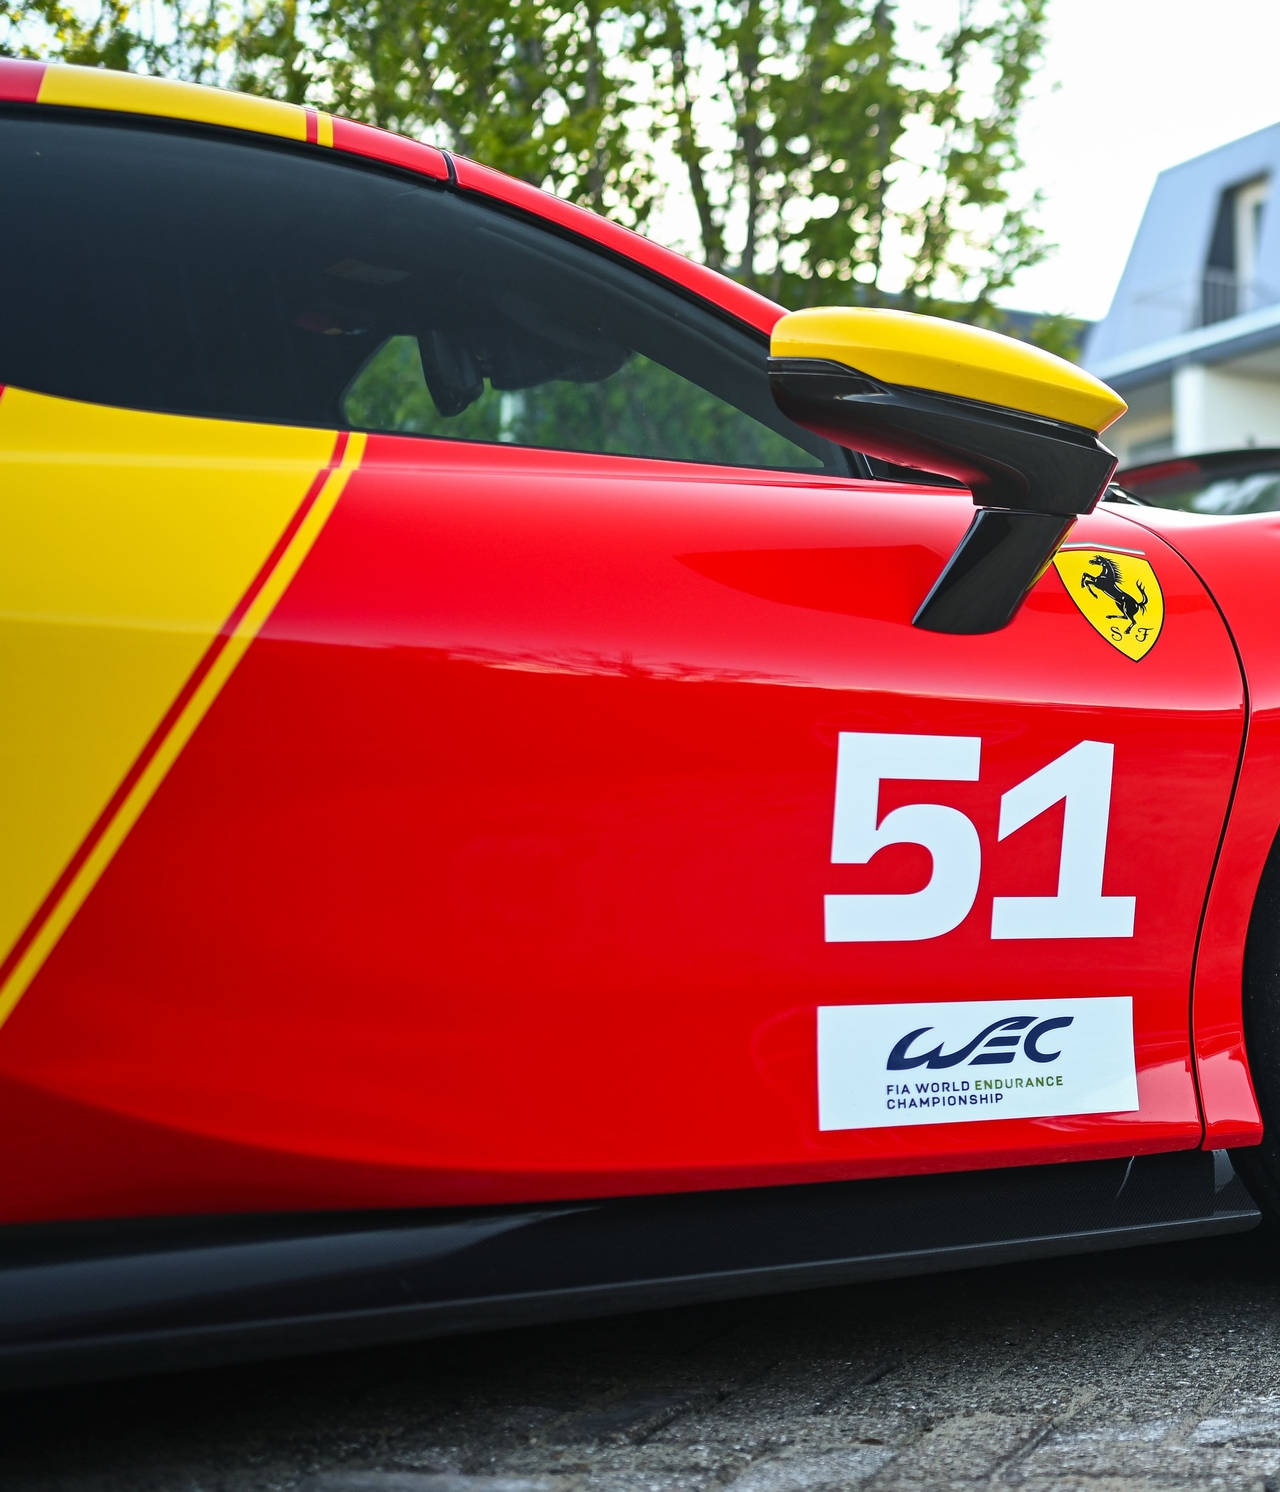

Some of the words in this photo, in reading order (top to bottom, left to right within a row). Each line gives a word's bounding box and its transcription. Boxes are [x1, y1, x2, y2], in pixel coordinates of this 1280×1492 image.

[1110, 626, 1123, 642] S
[1135, 627, 1154, 642] F
[824, 731, 1136, 942] 51
[886, 1016, 1074, 1070] WEC
[886, 1084, 911, 1095] FIA
[915, 1080, 970, 1094] WORLD
[975, 1075, 1064, 1091] ENDURANCE
[886, 1093, 1004, 1109] CHAMPIONSHIP
